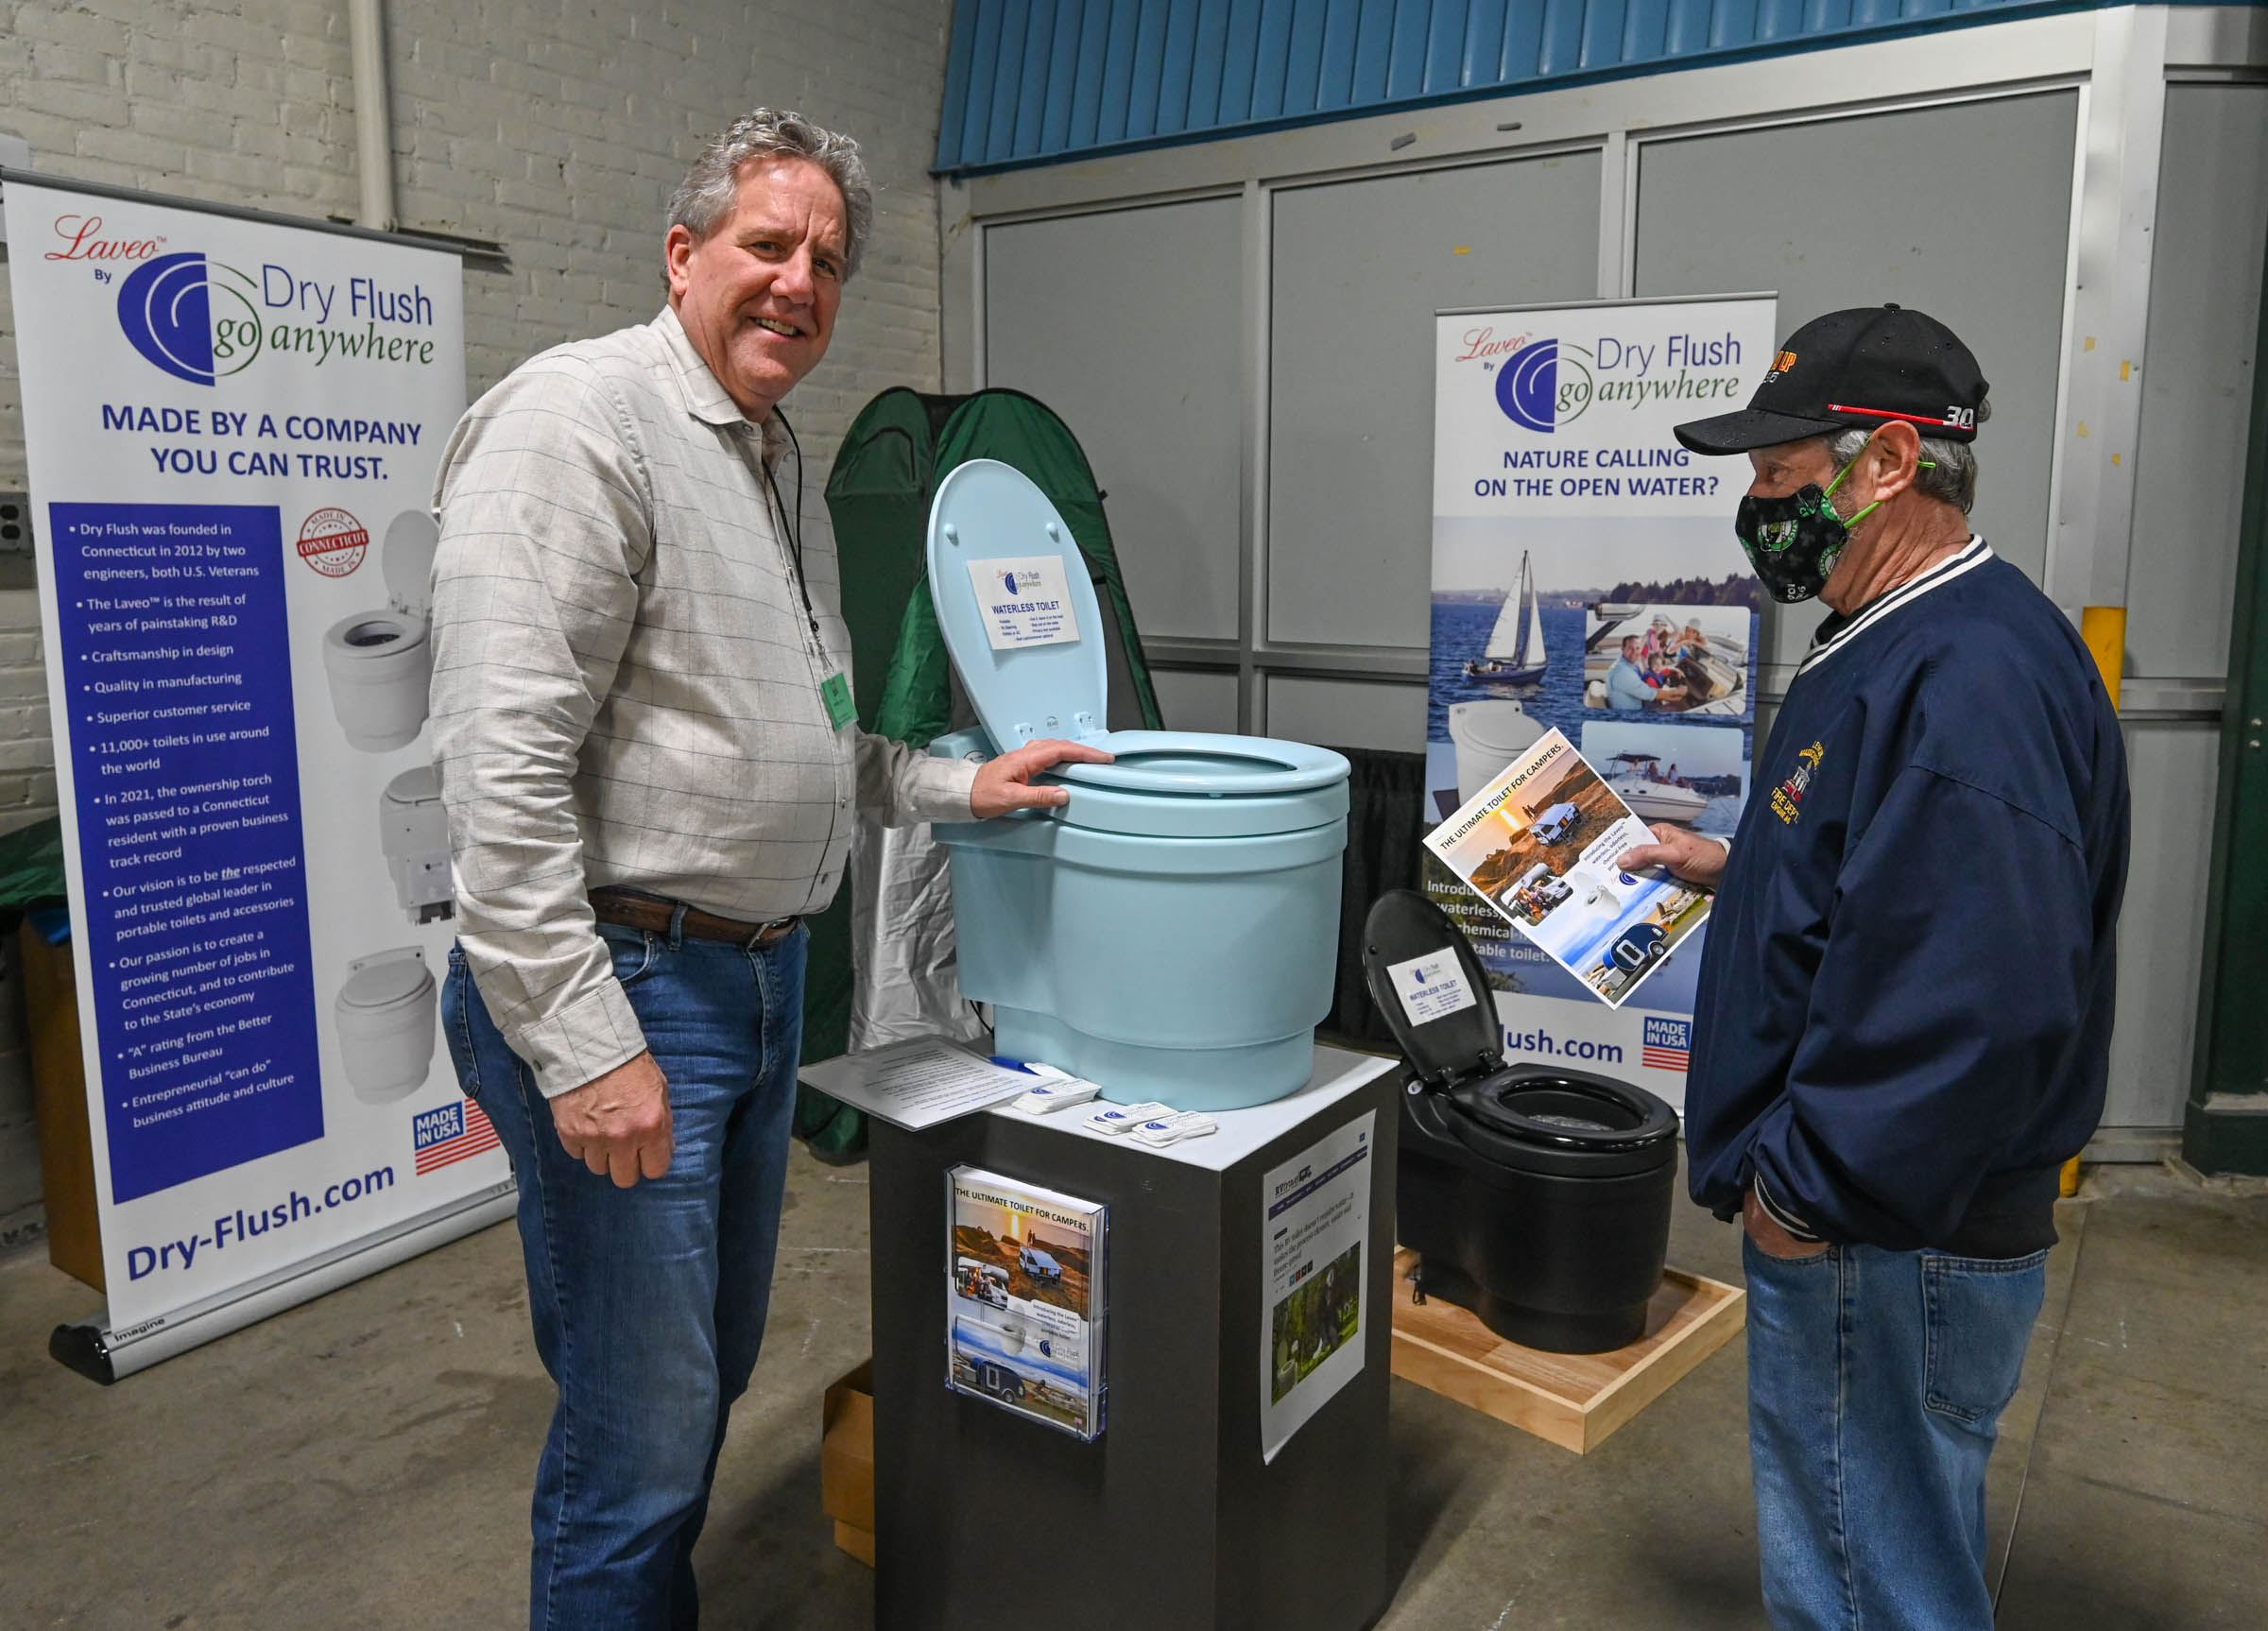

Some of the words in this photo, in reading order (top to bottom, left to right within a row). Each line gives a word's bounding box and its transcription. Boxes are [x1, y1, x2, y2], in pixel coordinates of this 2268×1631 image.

[94, 268, 112, 284] By
[263, 264, 335, 324] Dry
[351, 278, 432, 325] Flush
[213, 318, 258, 359] go
[270, 320, 435, 366] anywhere
[1598, 337, 1655, 377] Dry
[1668, 332, 1741, 367] Flush
[1484, 362, 1495, 371] By
[1555, 382, 1589, 412] go
[1598, 369, 1739, 410] anywhere
[102, 404, 201, 435] MADE
[212, 411, 248, 437] BY
[258, 414, 278, 438] A
[285, 416, 421, 445] COMPANY
[1945, 405, 1975, 429] 30
[150, 448, 216, 474] YOU
[229, 451, 288, 476] CAN
[296, 454, 387, 480] TRUST.
[1503, 450, 1589, 469] NATURE
[1595, 448, 1690, 467] CALLING
[1474, 479, 1506, 496] ON
[1513, 479, 1554, 496] THE
[1560, 478, 1620, 496] OPEN
[1628, 476, 1719, 496] WATER?
[80, 524, 103, 537] Dry
[106, 524, 139, 535] Flush
[142, 526, 166, 535] was
[169, 524, 217, 535] founded
[221, 524, 232, 535] in
[311, 512, 334, 525] MADE
[336, 512, 346, 521] IN
[81, 545, 157, 557] Connecticut
[160, 545, 171, 557] in
[175, 545, 203, 557] 2012
[206, 544, 220, 558] by
[223, 546, 246, 556] two
[299, 531, 367, 555] CONNECTICUT
[83, 568, 148, 581] engineers,
[151, 566, 180, 577] both
[183, 566, 206, 577] U.S.
[208, 566, 259, 577] Veterans
[86, 598, 112, 610] The
[114, 597, 160, 609] Laveo™
[163, 596, 173, 608] is
[176, 595, 196, 607] the
[198, 594, 232, 607] result
[233, 593, 246, 605] of
[991, 603, 1035, 614] WATERLESS
[1036, 600, 1059, 610] TOILET
[88, 622, 122, 634] years
[125, 618, 138, 630] of
[141, 616, 209, 632] painstaking
[211, 615, 237, 627] R&D
[92, 647, 180, 662] Craftsmanship
[182, 646, 194, 657] in
[197, 644, 233, 658] design
[94, 680, 140, 694] Quality
[143, 678, 154, 689] in
[157, 673, 242, 688] manufacturing
[97, 710, 149, 725] Superior
[153, 705, 208, 718] customer
[211, 700, 251, 713] service
[101, 739, 149, 753] 11,000+
[152, 735, 190, 748] toilets
[193, 733, 203, 744] in
[206, 732, 226, 743] use
[230, 726, 269, 740] around
[101, 764, 123, 775] the
[126, 757, 161, 772] world
[105, 794, 117, 805] In
[121, 789, 154, 803] 2021,
[157, 786, 177, 798] the
[180, 779, 240, 795] ownership
[242, 773, 272, 787] torch
[1439, 834, 1457, 850] THE
[1455, 808, 1489, 838] ULTIMATE
[1487, 787, 1512, 810] TOILET
[1511, 774, 1528, 790] FOR
[1526, 743, 1564, 776] CAMPERS.
[106, 815, 130, 826] was
[133, 806, 175, 825] passed
[177, 806, 190, 816] to
[193, 805, 199, 814] a
[202, 795, 269, 813] Connecticut
[108, 831, 158, 847] resident
[161, 826, 187, 839] with
[190, 826, 197, 835] a
[199, 820, 239, 835] proven
[242, 813, 288, 827] business
[110, 853, 141, 868] track
[144, 847, 181, 863] record
[112, 885, 136, 898] Our
[139, 880, 174, 893] vision
[177, 876, 186, 886] is
[188, 875, 201, 884] to
[203, 871, 218, 882] be
[221, 867, 240, 881] the
[243, 856, 296, 875] respected
[1427, 880, 1479, 897] Introdu
[114, 904, 138, 919] and
[141, 896, 183, 914] trusted
[186, 889, 220, 907] global
[223, 884, 259, 898] leader
[262, 882, 272, 892] in
[116, 920, 167, 942] portable
[170, 915, 206, 929] toilets
[209, 907, 231, 921] and
[233, 898, 294, 917] accessories
[1473, 944, 1506, 957] table
[122, 985, 197, 1010] Connecticut,
[199, 977, 221, 992] and
[223, 977, 235, 987] to
[238, 964, 294, 983] contribute
[128, 1044, 146, 1057] “A”
[150, 1037, 184, 1053] rating
[186, 1030, 215, 1043] from
[216, 1024, 235, 1036] the
[238, 1015, 272, 1030] Better
[1647, 1021, 1686, 1036] MADE
[1647, 1032, 1659, 1044] IN
[1662, 1034, 1687, 1048] USA
[1499, 1023, 1623, 1064] lush.com
[129, 1059, 180, 1080] Business
[182, 1047, 223, 1065] Bureau
[131, 1070, 223, 1108] Entrepreneurial
[225, 1068, 249, 1080] “can
[251, 1059, 271, 1073] do”
[133, 1107, 183, 1128] business
[186, 1092, 231, 1112] attitude
[233, 1083, 254, 1099] and
[256, 1074, 294, 1091] culture
[416, 1107, 458, 1132] MADE
[417, 1129, 431, 1146] IN
[433, 1122, 461, 1142] USA
[954, 1187, 971, 1197] THE
[971, 1191, 1008, 1208] ULTIMATE
[1010, 1200, 1034, 1213] TOILET
[1036, 1208, 1050, 1219] FOR
[1051, 1213, 1090, 1232] CAMPERS.
[128, 1165, 395, 1282] Dry-Flush.com
[113, 1316, 165, 1343] Imagine
